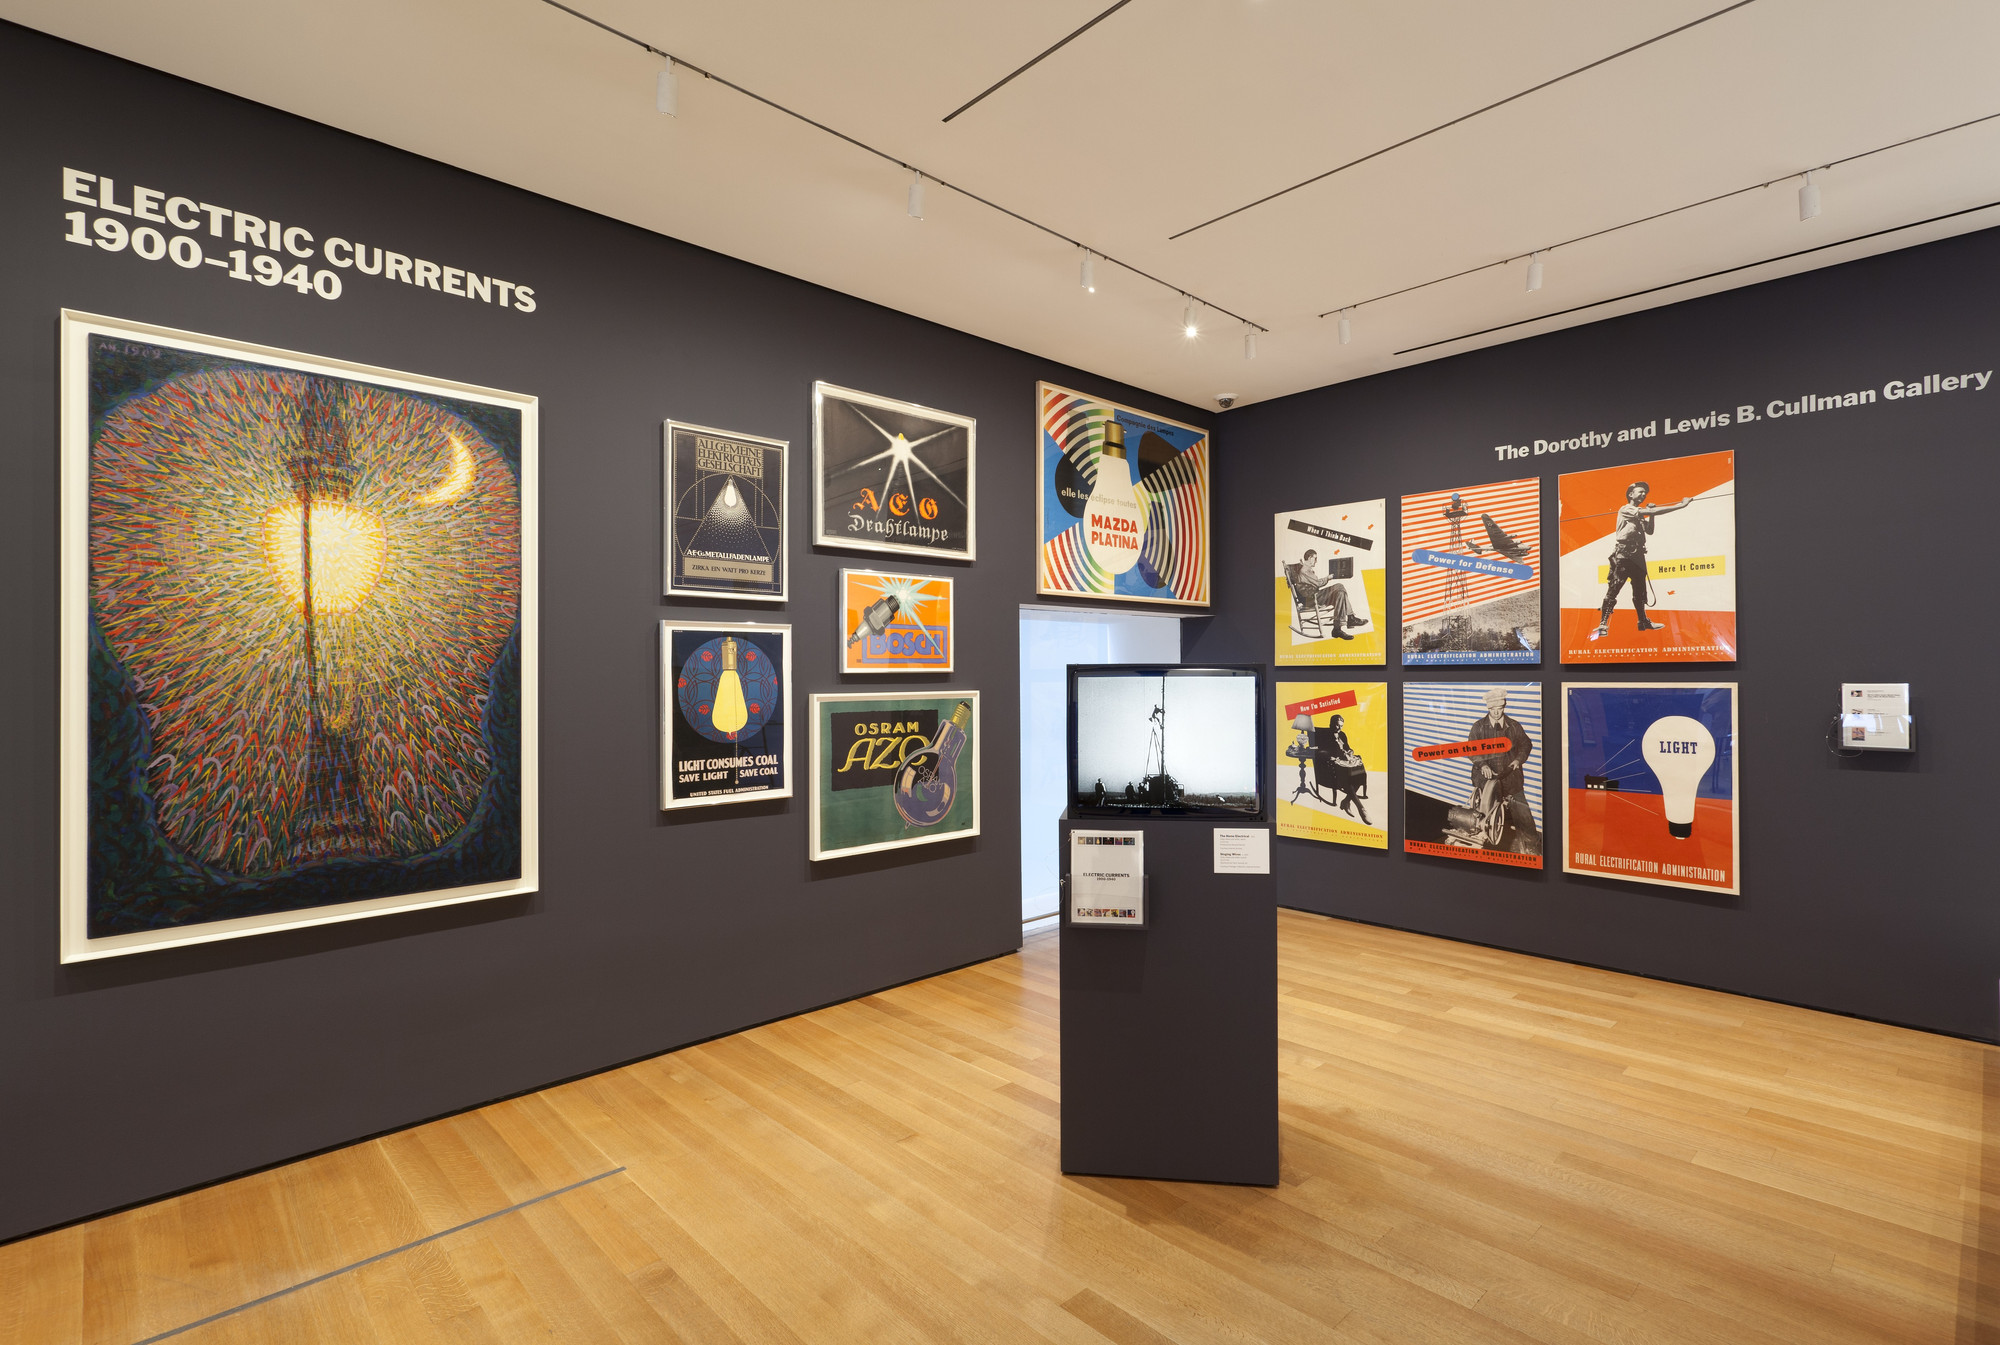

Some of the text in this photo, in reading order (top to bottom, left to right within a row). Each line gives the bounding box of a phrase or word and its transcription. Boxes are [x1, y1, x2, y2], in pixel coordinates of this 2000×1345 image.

[62, 166, 537, 313] ELECTRIC CURRENTS
[1495, 370, 1993, 461] The Dorothy and Lewis B. Cullman Gallery
[697, 438, 762, 458] ALLGEMEINE
[698, 458, 762, 476] GESELLSCHAFT
[1061, 487, 1076, 498] elle
[1078, 490, 1088, 500] les
[1116, 499, 1137, 509] toutes
[848, 511, 949, 544] Drahtlampe
[1091, 513, 1138, 534] MAZDA
[1307, 526, 1320, 534] When
[1091, 530, 1139, 550] PLATINA
[1428, 554, 1514, 574] Power for Defense
[1690, 562, 1715, 570] Comes
[870, 632, 941, 656] BOSCH
[1319, 698, 1341, 708] Satisfied
[854, 721, 919, 736] OSRAM
[837, 735, 931, 771] AZO
[1659, 741, 1698, 754] LIGHT
[679, 754, 778, 772] LIGHT CONSUMES COAL
[679, 766, 778, 783] SAVE LIGHT SAVE COAL
[1576, 853, 1726, 882] RURAL ELECTRIFICATION ADMINISTRATION
